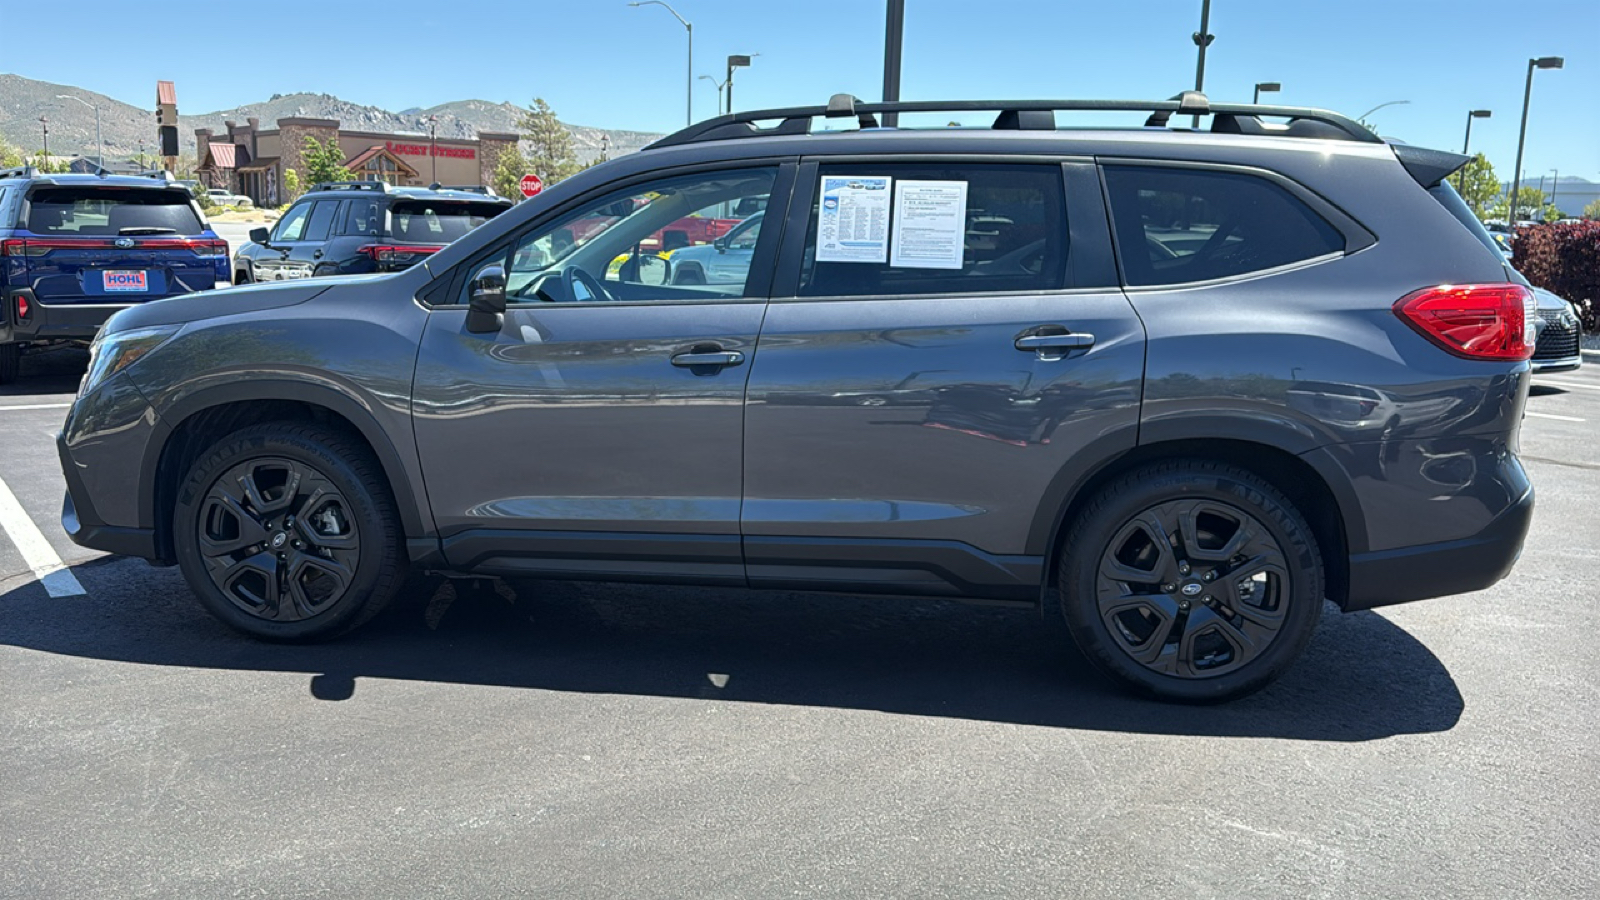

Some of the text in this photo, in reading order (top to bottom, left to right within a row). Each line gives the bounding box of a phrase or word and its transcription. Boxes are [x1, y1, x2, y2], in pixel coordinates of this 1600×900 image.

[386, 142, 475, 159] LUCKY STRIKE
[522, 181, 541, 191] STOP
[108, 275, 142, 284] HOHL
[187, 437, 254, 496] ADVANTA
[1231, 484, 1308, 556] ADVANTA
